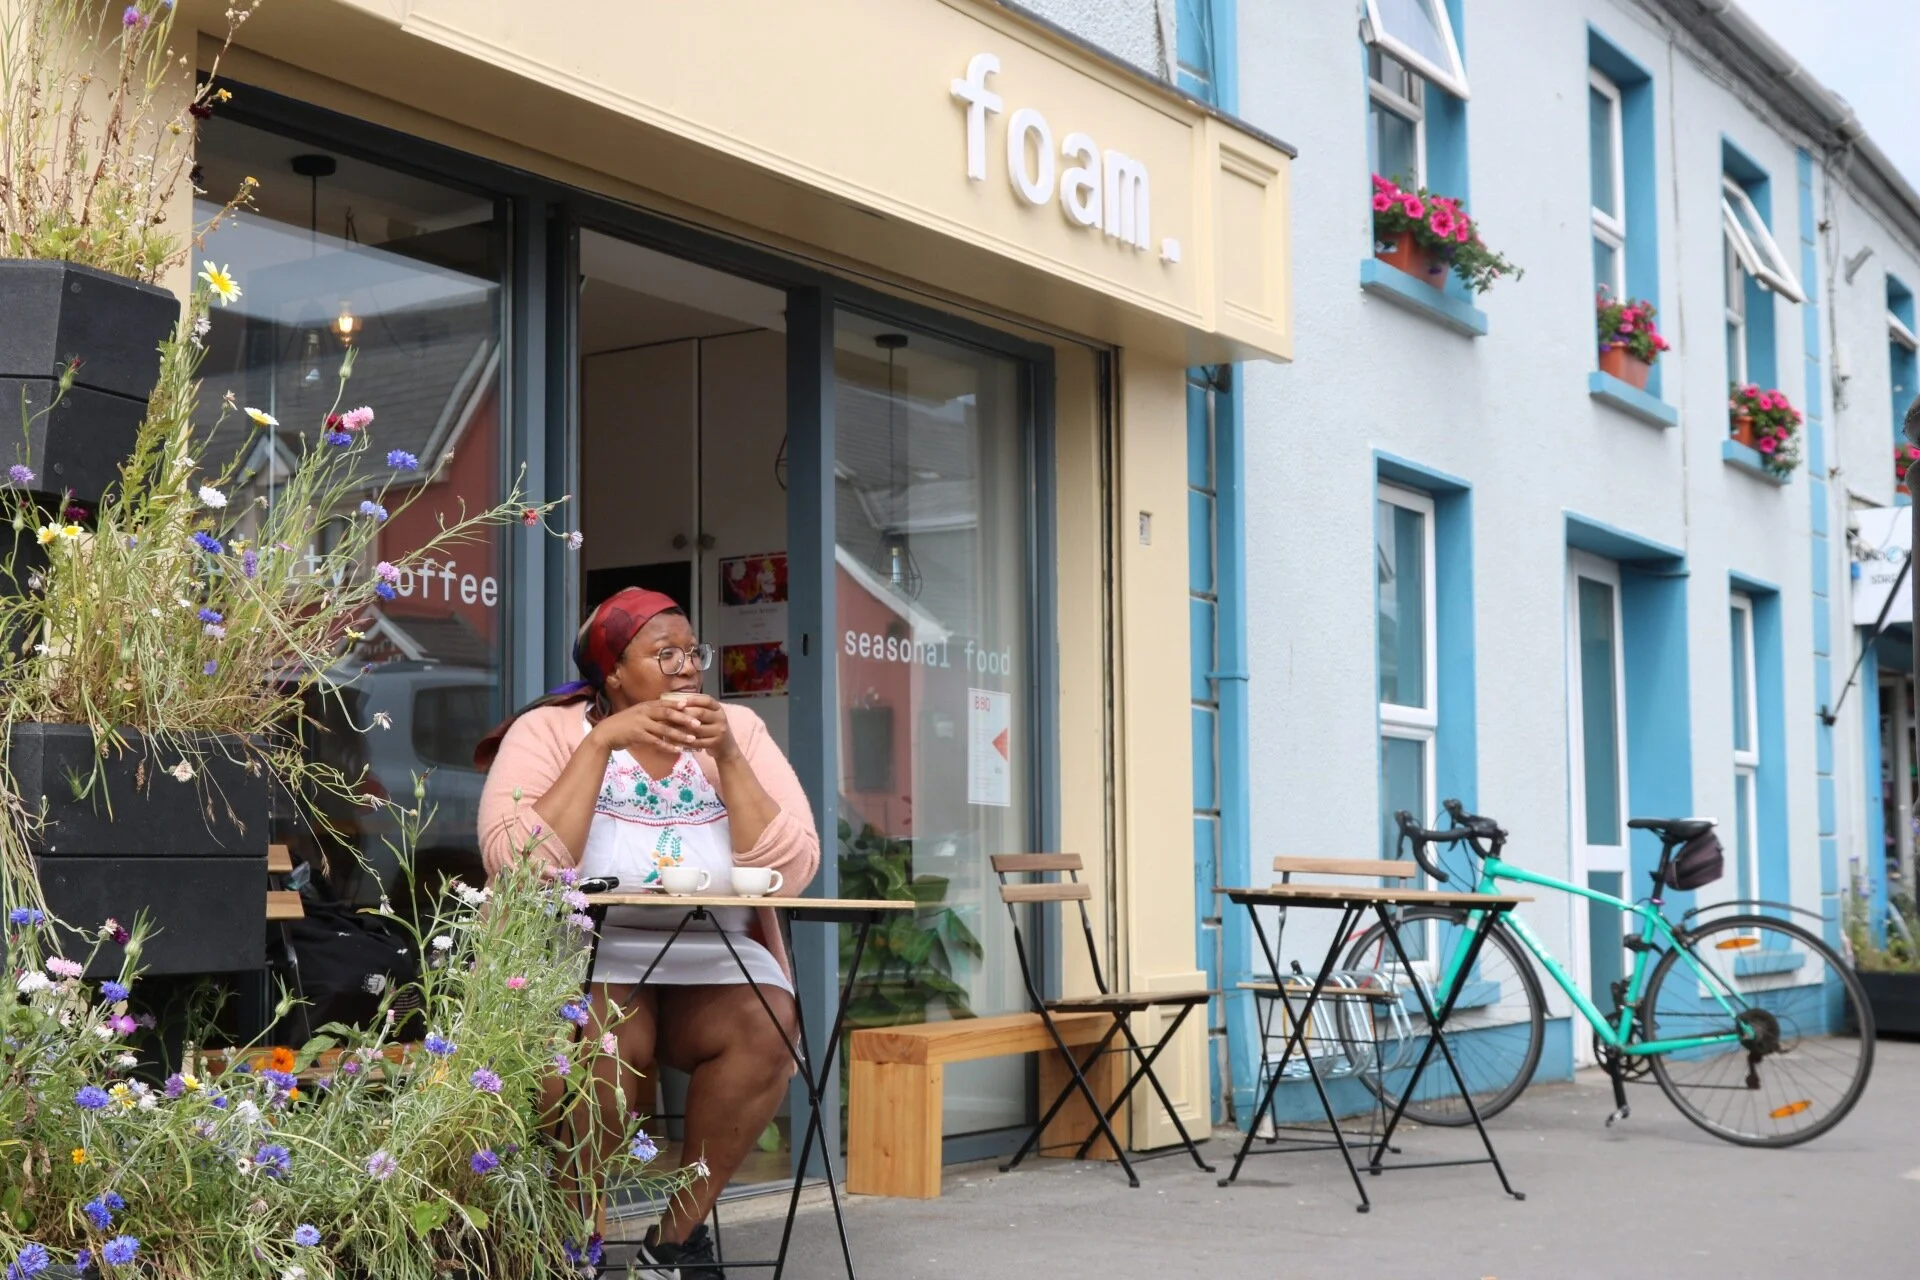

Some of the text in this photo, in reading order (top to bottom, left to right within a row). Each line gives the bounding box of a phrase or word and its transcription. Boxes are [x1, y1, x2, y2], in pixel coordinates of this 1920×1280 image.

[950, 53, 1181, 263] foam.
[393, 558, 499, 607] offee
[844, 630, 1011, 676] seasonal food
